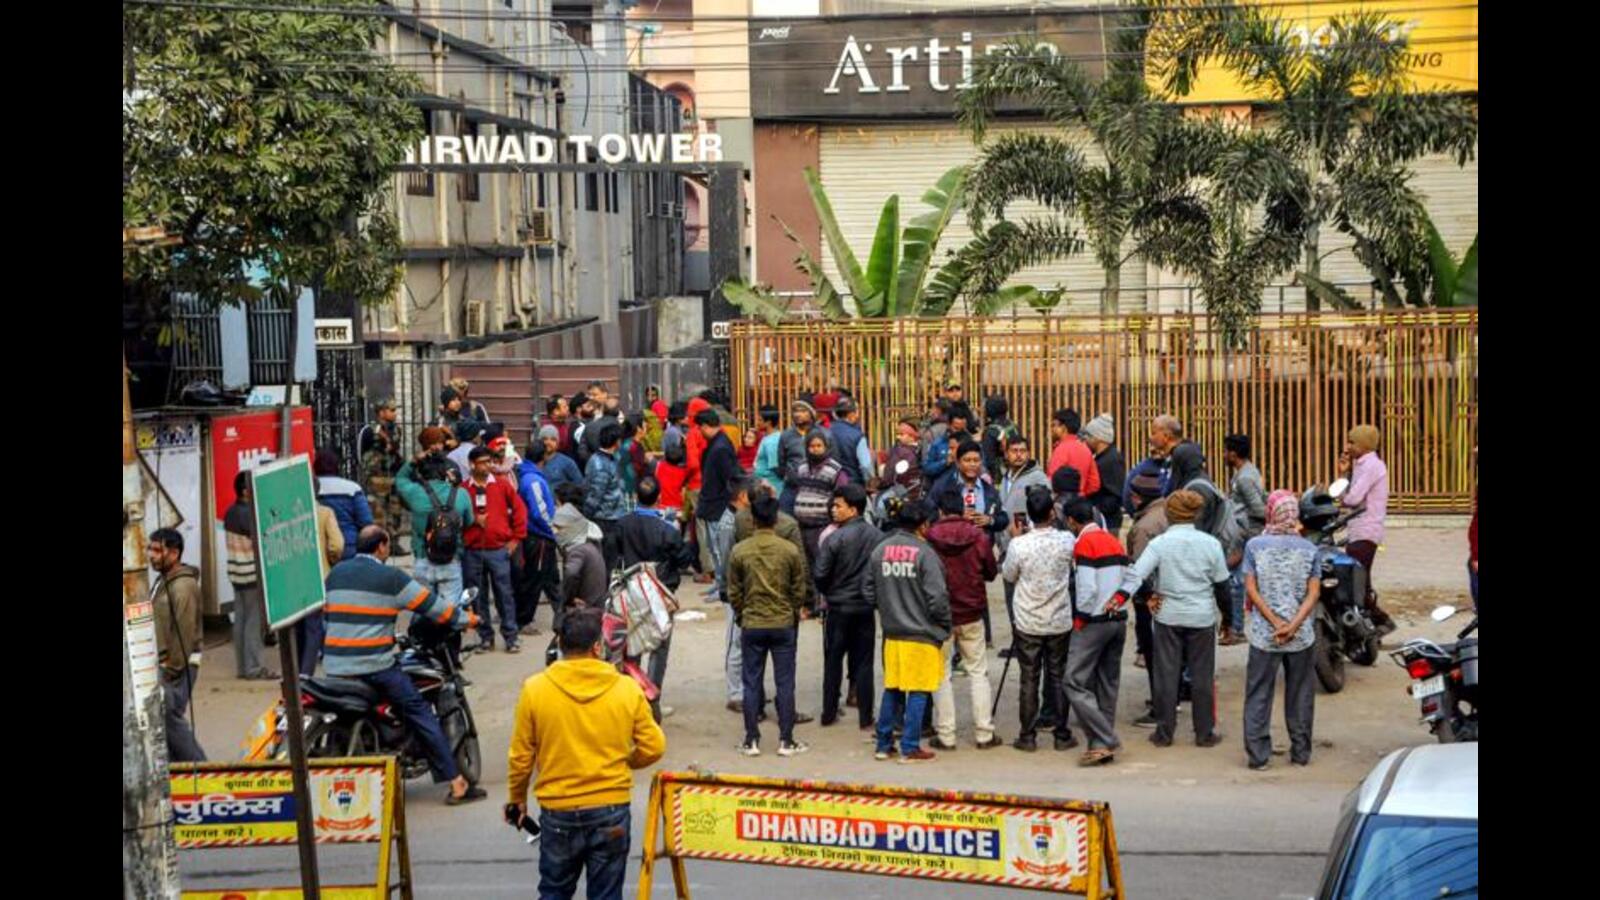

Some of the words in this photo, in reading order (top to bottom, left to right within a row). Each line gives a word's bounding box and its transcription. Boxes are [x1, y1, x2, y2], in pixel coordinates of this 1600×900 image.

[570, 133, 723, 163] TOWER
[314, 325, 348, 341] कास
[883, 545, 919, 562] JUST
[173, 793, 285, 825] पुलिस
[742, 812, 876, 848] DHANBAD
[886, 823, 994, 858] POLICE
